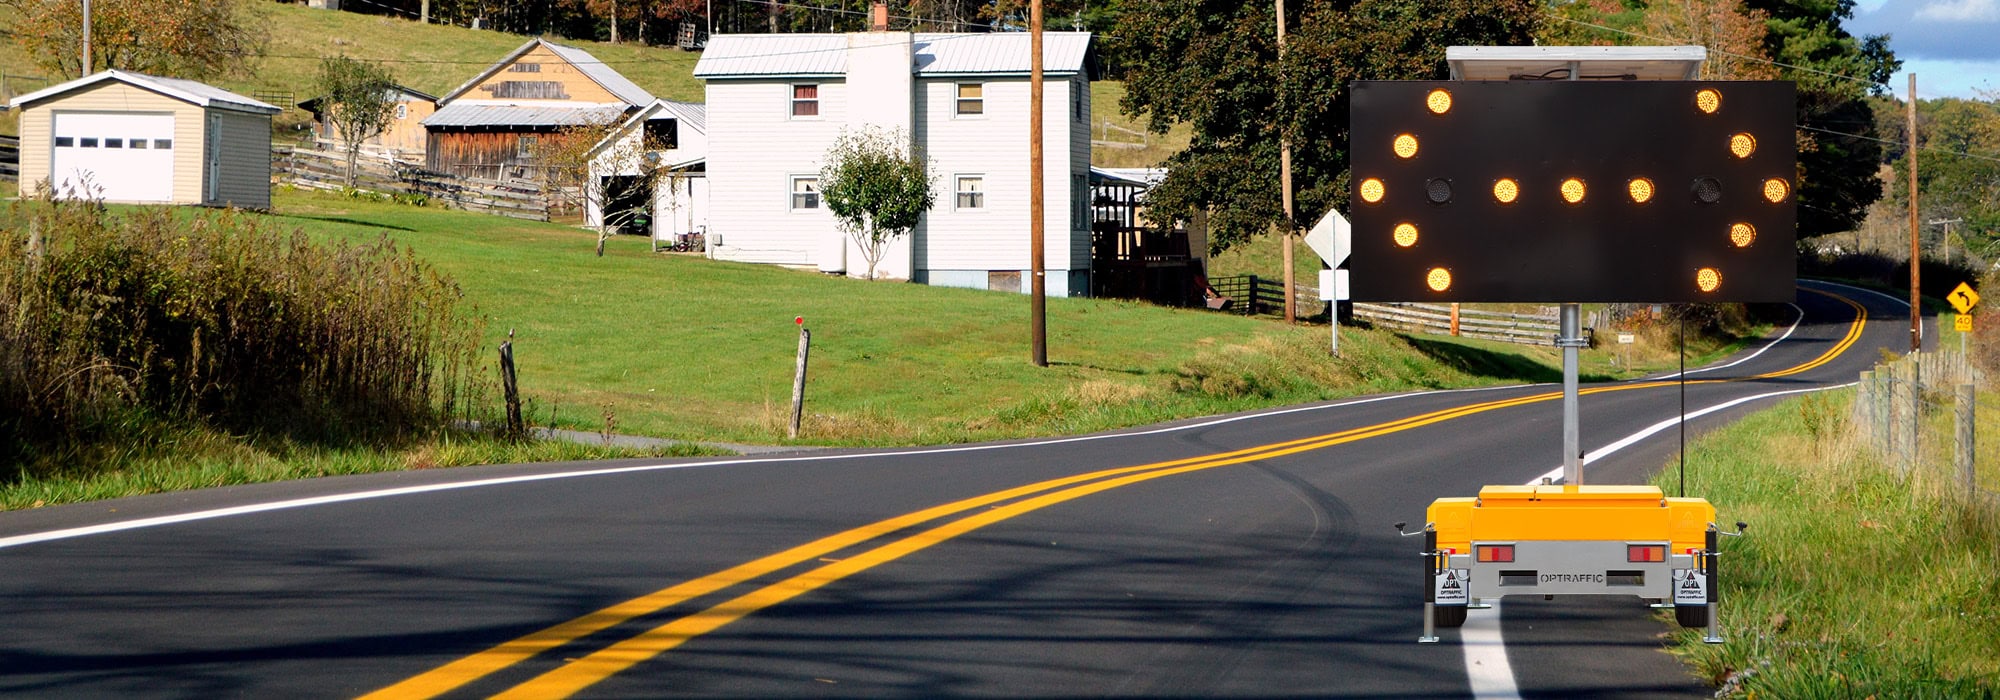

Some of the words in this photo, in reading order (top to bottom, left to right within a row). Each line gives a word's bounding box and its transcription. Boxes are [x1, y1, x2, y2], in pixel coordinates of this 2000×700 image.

[1957, 317, 1970, 325] 40
[1540, 574, 1604, 583] OPTRAFFIC
[1445, 580, 1458, 588] OPT
[1684, 580, 1697, 588] OPT
